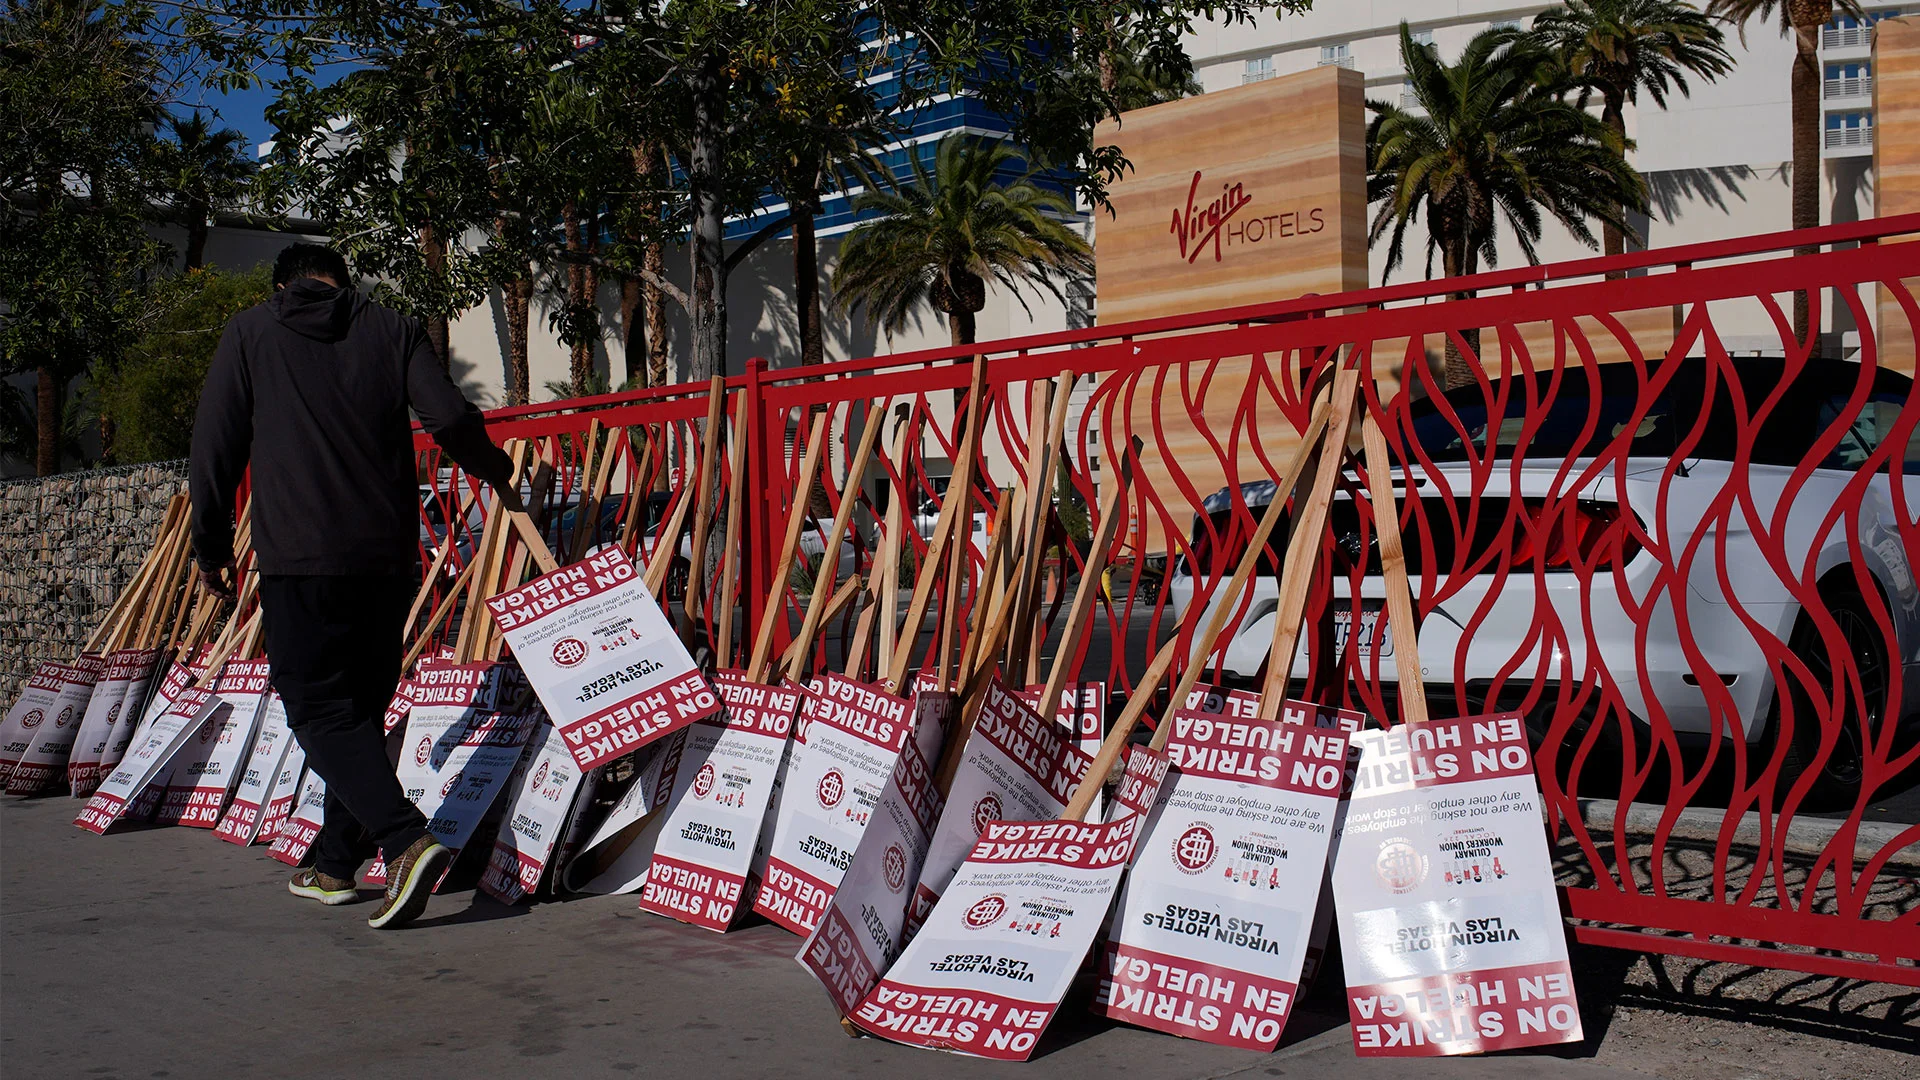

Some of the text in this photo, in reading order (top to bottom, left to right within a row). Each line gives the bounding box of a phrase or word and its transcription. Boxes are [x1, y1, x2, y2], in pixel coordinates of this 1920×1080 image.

[1170, 171, 1252, 264] Virgin
[1227, 208, 1325, 246] HOTELS
[488, 548, 625, 611] EN HUELGA
[496, 563, 632, 629] ON STRIKE
[601, 596, 620, 606] other
[622, 589, 635, 598] any
[632, 592, 644, 600] We
[567, 604, 600, 619] employer
[580, 609, 604, 620] asking
[527, 624, 566, 645] employees
[541, 622, 557, 632] stop
[592, 617, 633, 636] WORKERS UNION
[603, 625, 627, 637] CULINARY
[174, 669, 189, 685] EN
[254, 664, 270, 675] EN
[420, 669, 473, 685] HUELGA
[581, 659, 649, 693] LAS VEGAS
[30, 676, 66, 690] RIKE
[164, 682, 180, 698] ON
[246, 677, 265, 690] ON
[575, 661, 664, 703] VIRGIN HOTEL
[670, 675, 706, 698] EN
[414, 686, 466, 703] STRIKE
[770, 692, 796, 712] EN
[828, 677, 905, 723] HUELGA
[389, 697, 412, 713] EN
[675, 691, 715, 719] ON
[565, 693, 668, 746] HUELGA
[758, 712, 790, 733] ON
[818, 708, 893, 746] STRIKE
[990, 684, 1061, 760] HUELGA
[574, 711, 672, 765] STRIKE
[978, 706, 1050, 783] STRIKE
[1175, 717, 1345, 761] EN HUELGA
[1344, 718, 1522, 758] EN HUELG
[994, 763, 1008, 776] stop
[1167, 742, 1281, 781] STRIKE
[1343, 746, 1528, 793] ON STRIK
[977, 760, 1008, 790] employees
[1007, 775, 1014, 784] to
[1291, 761, 1340, 789] ON
[167, 791, 222, 805] EN HUELGA
[407, 788, 425, 797] EGAS
[1008, 788, 1018, 800] the
[1014, 779, 1039, 805] employer
[1195, 790, 1214, 802] stop
[1217, 796, 1224, 805] to
[1469, 795, 1497, 806] other
[1501, 791, 1521, 802] any
[106, 800, 120, 814] EN
[1226, 796, 1271, 812] employer
[1274, 805, 1300, 817] other
[1401, 806, 1410, 815] to
[1469, 806, 1488, 817] not
[1491, 804, 1509, 814] are
[1512, 801, 1532, 811] We
[96, 814, 112, 830] ON
[160, 805, 217, 822] ON STRIKE
[240, 808, 257, 822] EN
[1155, 797, 1325, 834] We are not asking the employees of
[1302, 809, 1320, 820] any
[1373, 807, 1396, 820] stop
[1430, 809, 1467, 821] asking
[235, 824, 251, 839] ON
[300, 828, 316, 842] EN
[687, 821, 732, 840] LAS VEGAS
[986, 817, 1135, 844] EN HUELGA
[1347, 819, 1407, 835] employees
[680, 829, 735, 851] VIRGIN HOTEL
[807, 835, 837, 855] VEGAS
[1439, 837, 1504, 851] WORKERS UNION
[291, 845, 306, 859] ON
[798, 841, 828, 865] HOTEL
[970, 840, 1129, 864] ON STRIKE
[1232, 840, 1288, 859] WORKERS UNION
[1241, 851, 1275, 866] CULINARY
[1454, 848, 1491, 859] CULINARY
[652, 862, 741, 901] EN HUELGA
[644, 882, 734, 924] ON STRIKE
[1021, 902, 1074, 917] WORKERS UNION
[1028, 910, 1060, 921] CULINARY
[1166, 904, 1264, 938] LAS VEGAS
[1142, 912, 1280, 955] VIRGIN HOTELS
[1396, 917, 1501, 940] LAS VEGAS
[1451, 928, 1520, 946] VIRGIN
[827, 914, 873, 996] ELGA
[944, 954, 1029, 971] LAS VEGAS
[809, 935, 858, 1011] RIKE
[929, 962, 1035, 982] VIRGIN HOTEL
[1108, 953, 1289, 1015] EN HUELGA
[1353, 973, 1570, 1019] EN HUELGA
[877, 986, 1049, 1028] EN HUELGA
[1094, 979, 1281, 1043] ON STRIKE
[856, 1001, 1036, 1052] ON STRIKE
[1356, 1004, 1577, 1047] ON STRIKE
